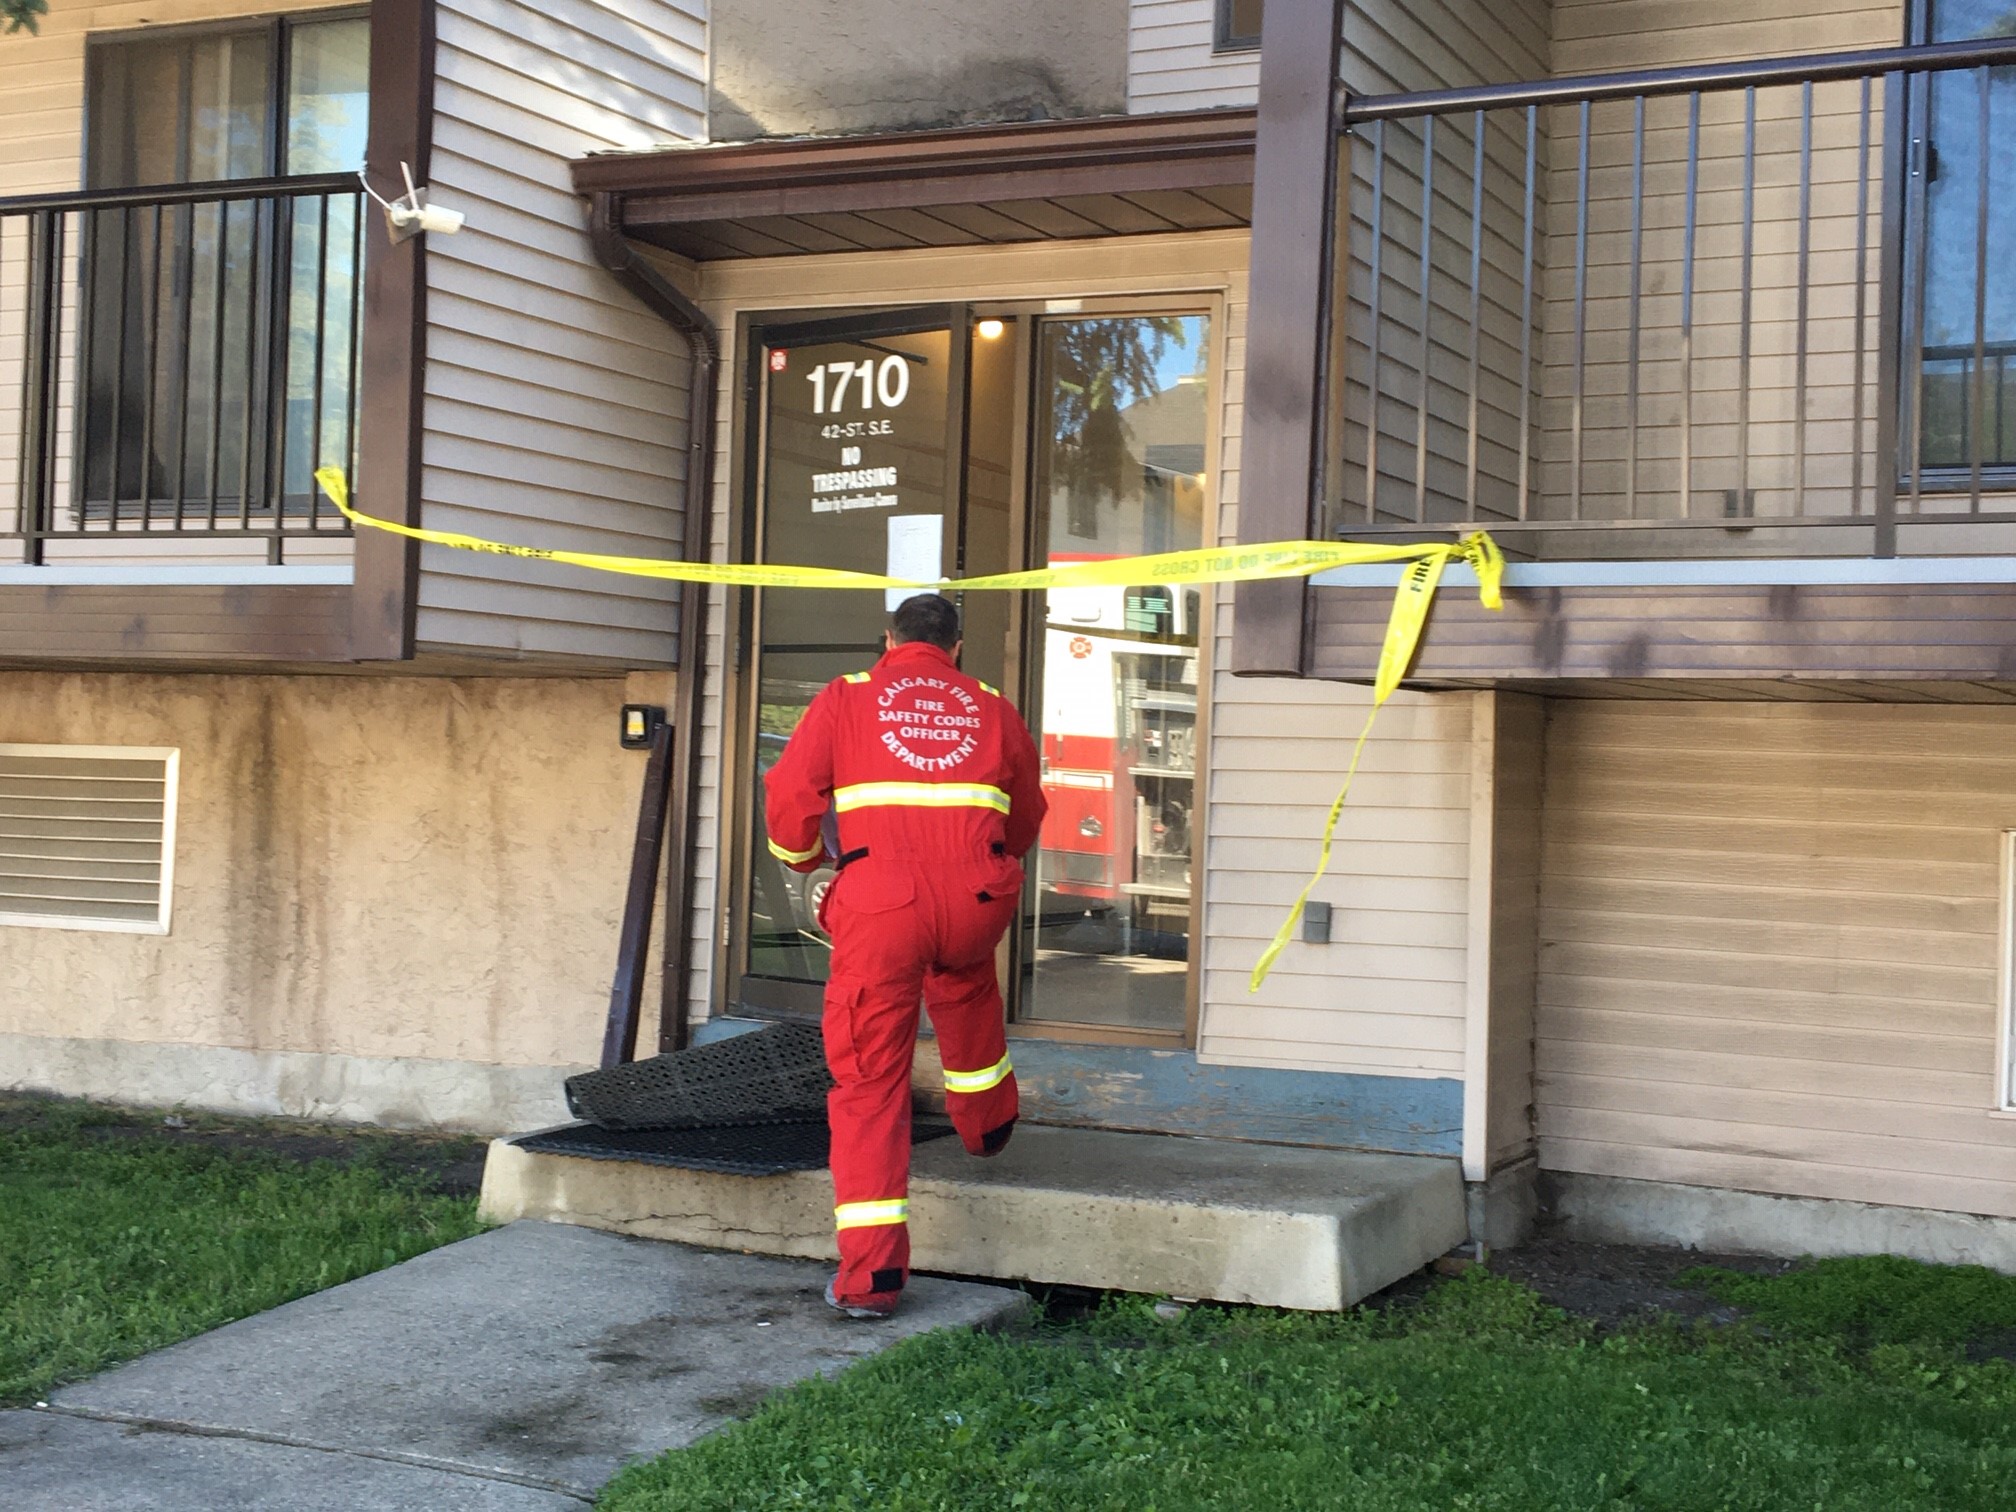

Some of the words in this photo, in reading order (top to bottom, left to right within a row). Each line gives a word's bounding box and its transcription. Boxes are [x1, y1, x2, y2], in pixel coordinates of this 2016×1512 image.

[806, 355, 910, 414] 1710
[868, 420, 894, 435] S.E.
[841, 446, 861, 466] NO
[812, 467, 897, 493] TRESPASSING
[1410, 559, 1434, 592] FIRE
[877, 677, 949, 707] CALGARY
[949, 686, 980, 714] FIRE
[914, 699, 945, 712] FIRE
[878, 710, 930, 725] SAFETY
[933, 715, 981, 728] CODES
[900, 726, 961, 741] OFFICER
[880, 731, 978, 772] DEPARTMENT
